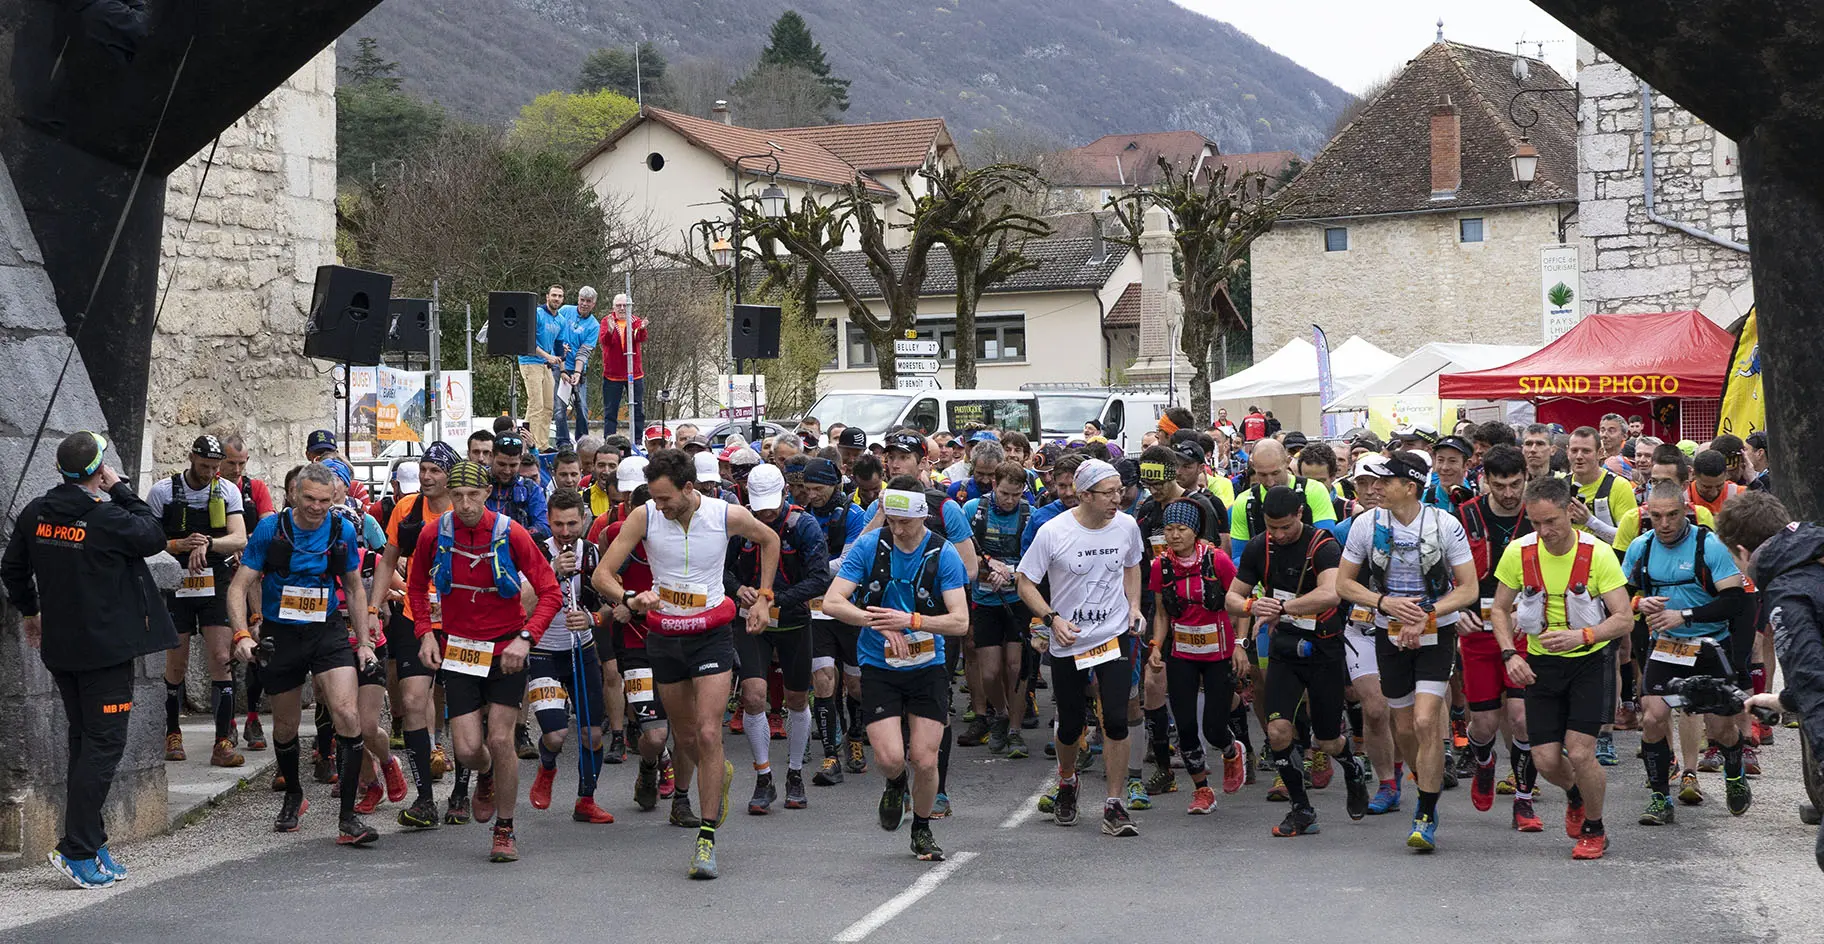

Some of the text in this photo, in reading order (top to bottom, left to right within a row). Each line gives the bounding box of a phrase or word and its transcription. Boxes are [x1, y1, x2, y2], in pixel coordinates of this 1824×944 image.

[1543, 256, 1566, 264] OFFICE
[1544, 264, 1577, 272] TOURISME
[897, 343, 936, 351] BELLEY 27
[897, 361, 936, 369] MORESTEL 13
[1518, 375, 1679, 395] STAND PHOTO
[36, 523, 86, 542] MB PROD
[188, 577, 205, 588] 078
[299, 597, 316, 611] 196
[673, 591, 694, 607] 094
[1190, 633, 1206, 645] 168
[460, 648, 481, 664] 058
[627, 678, 642, 692] 046
[540, 686, 556, 699] 129
[103, 704, 117, 714] MB
